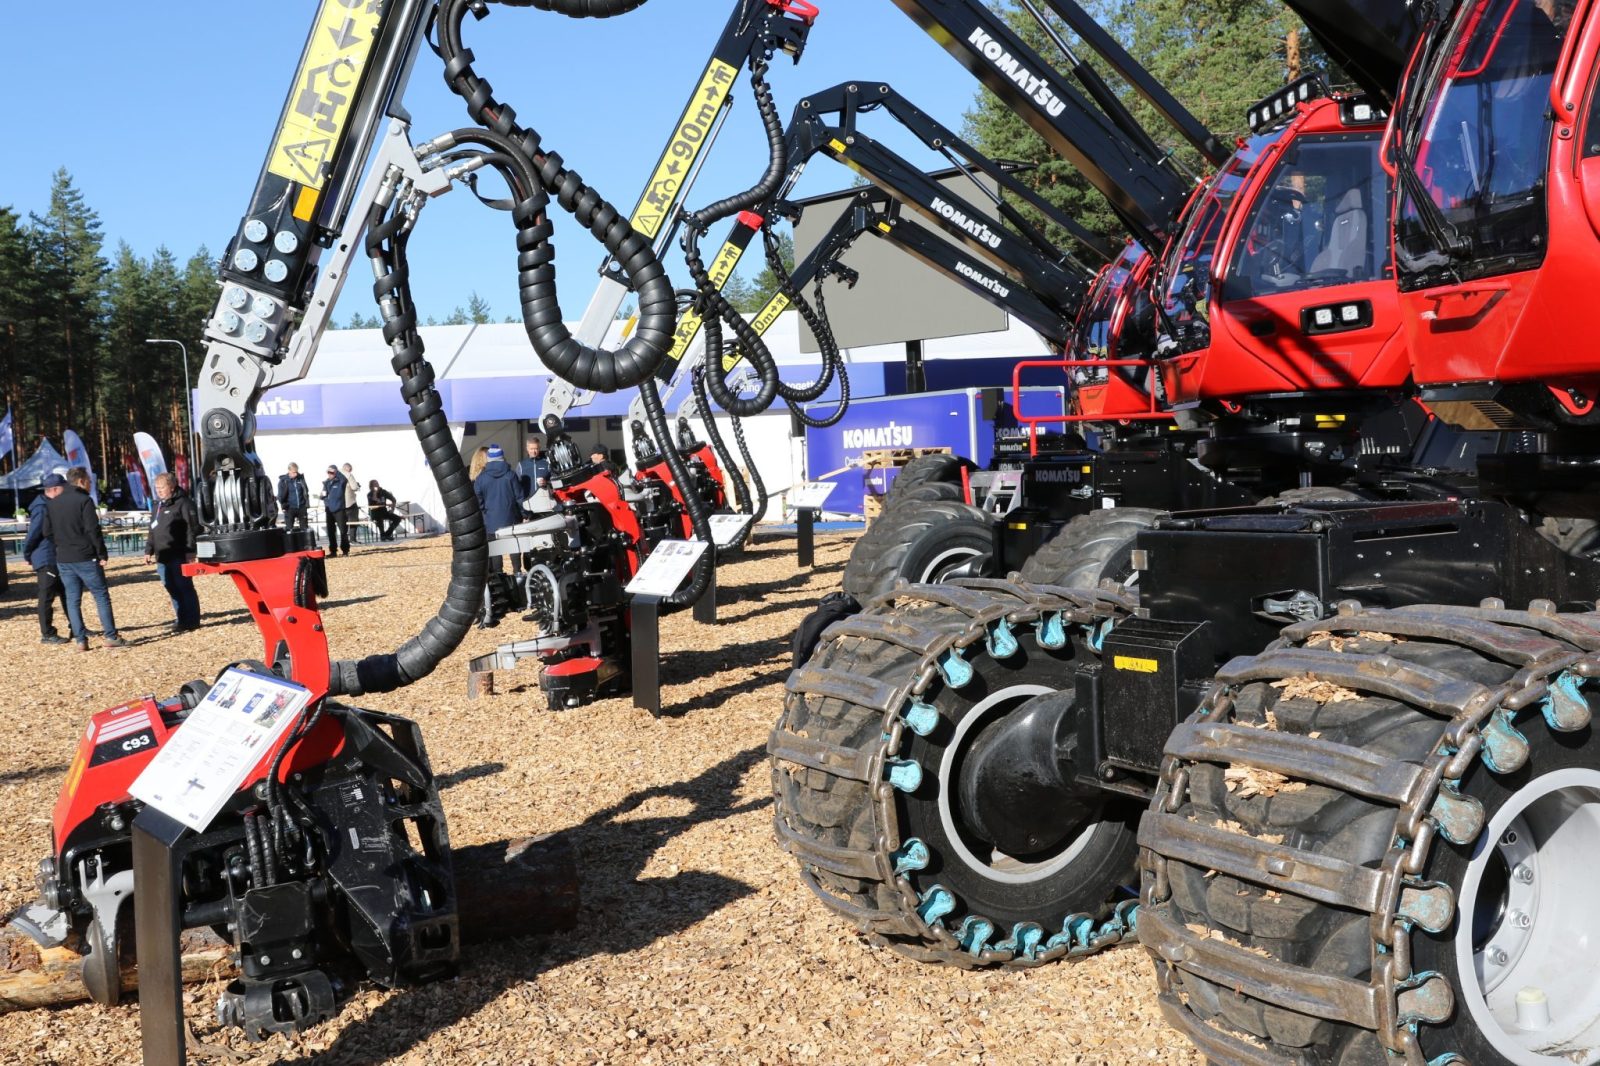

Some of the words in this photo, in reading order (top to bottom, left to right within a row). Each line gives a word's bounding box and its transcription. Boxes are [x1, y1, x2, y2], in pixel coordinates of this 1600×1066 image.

[967, 26, 1067, 118] KOMATSU
[671, 103, 715, 160] 90m
[930, 196, 1002, 249] KOMATSU
[954, 261, 1010, 298] KOMATSU
[754, 313, 774, 331] 0m
[254, 396, 304, 415] ATSU
[842, 421, 913, 449] KOMATSU
[1035, 466, 1080, 482] KOMATSU
[122, 735, 150, 751] C93
